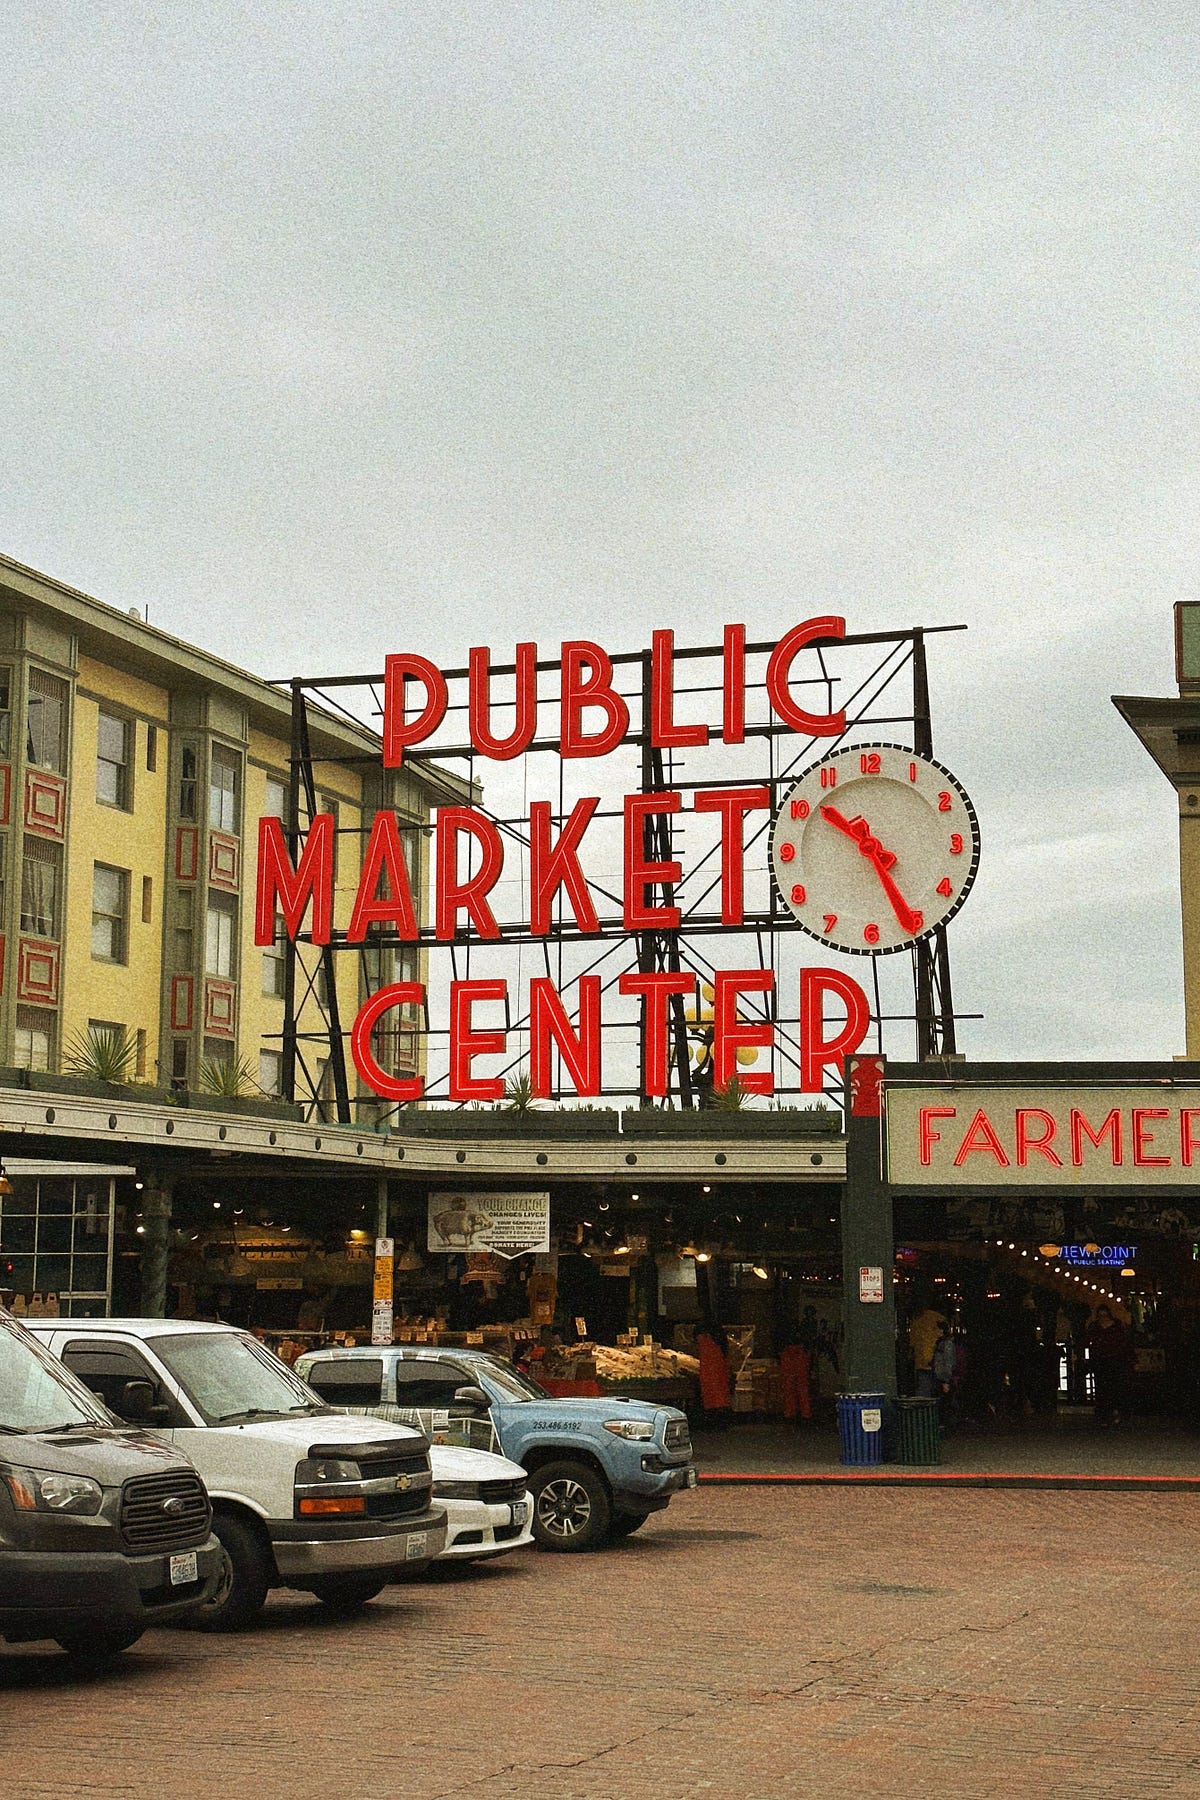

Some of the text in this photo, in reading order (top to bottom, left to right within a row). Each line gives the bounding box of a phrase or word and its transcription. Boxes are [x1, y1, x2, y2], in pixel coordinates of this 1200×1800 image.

[383, 615, 847, 768] PUBLIC
[860, 753, 881, 774] 12
[909, 762, 917, 782] 1
[820, 767, 836, 788] 11
[790, 799, 810, 819] 10
[937, 791, 952, 811] 2
[780, 843, 795, 862] 9
[949, 833, 963, 854] 3
[254, 786, 771, 947] MARKET
[791, 884, 806, 905] 8
[935, 877, 953, 897] 4
[823, 914, 838, 933] 7
[911, 910, 924, 930] 5
[863, 923, 880, 944] 6
[350, 967, 870, 1103] CENTER
[477, 1198, 547, 1212] YOUR CHANGE
[1057, 1245, 1138, 1259] VIEWPOINT
